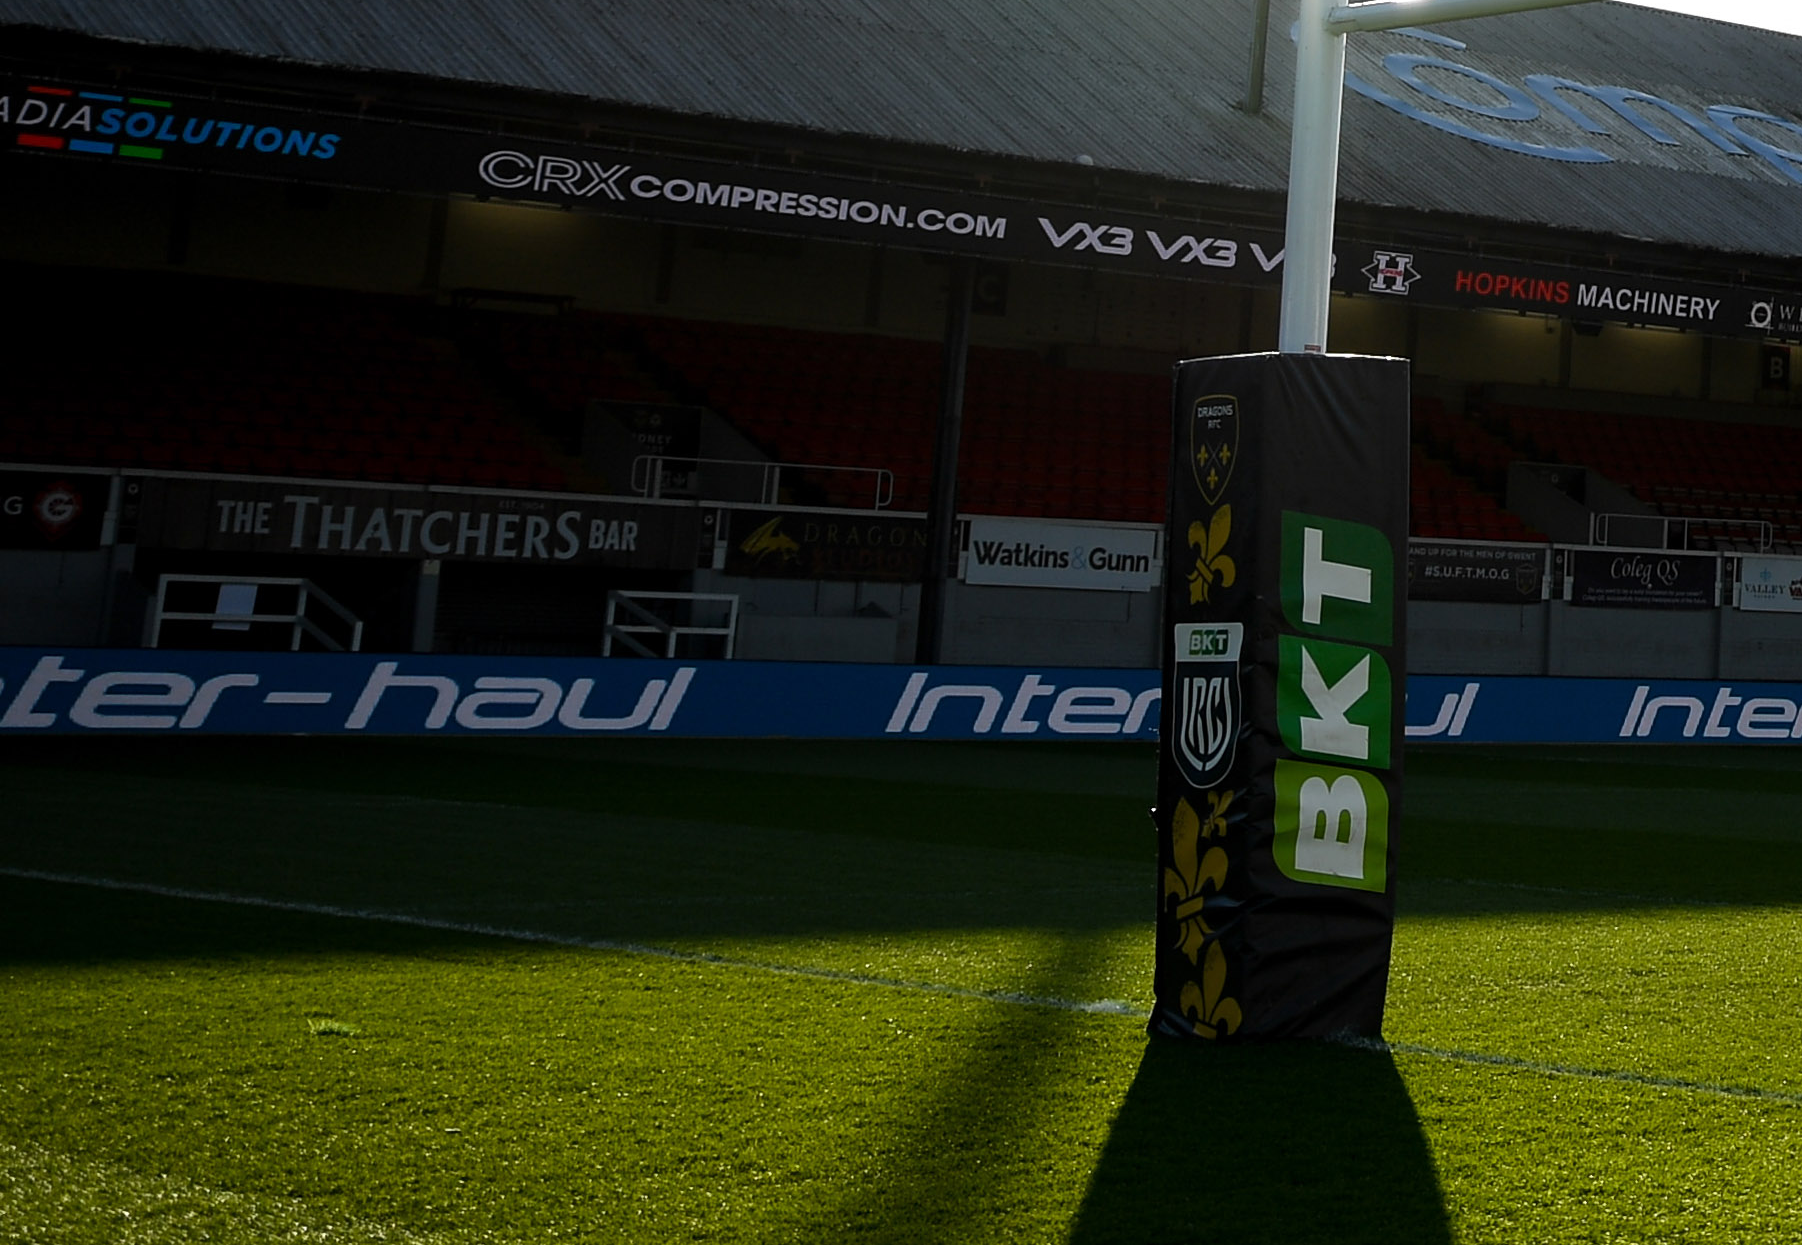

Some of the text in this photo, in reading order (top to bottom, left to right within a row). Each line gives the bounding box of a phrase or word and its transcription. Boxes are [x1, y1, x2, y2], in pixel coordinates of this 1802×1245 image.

[1037, 217, 1134, 255] VX3
[1146, 230, 1237, 267] VX3
[1455, 270, 1720, 321] HOPKINS MACHINERY
[1197, 405, 1233, 417] DRAGONS
[216, 495, 639, 560] THE THATCHERS BAR
[1408, 546, 1426, 556] AND
[1610, 555, 1681, 586] Coleg QS
[1745, 584, 1785, 594] VALLEY
[1191, 634, 1227, 651] BKT
[0, 656, 696, 731] ter-haul
[1295, 526, 1371, 879] BKT
